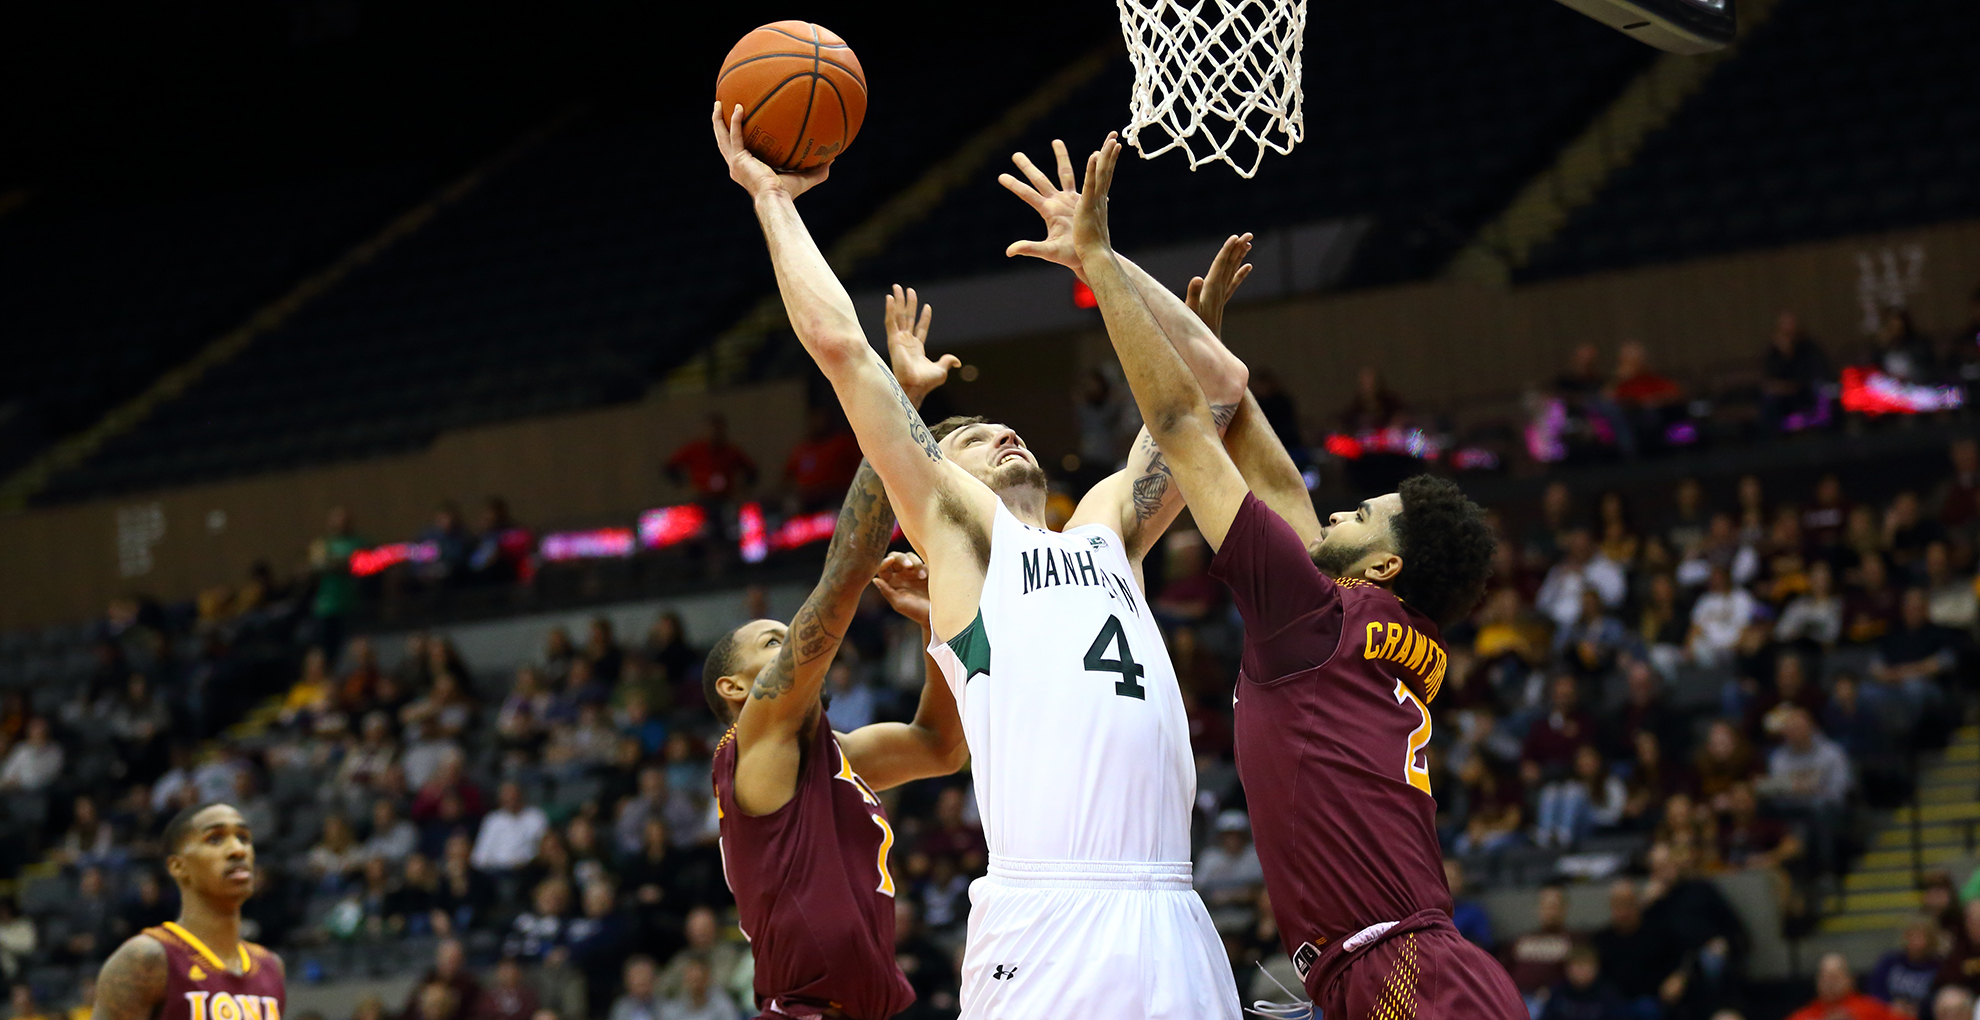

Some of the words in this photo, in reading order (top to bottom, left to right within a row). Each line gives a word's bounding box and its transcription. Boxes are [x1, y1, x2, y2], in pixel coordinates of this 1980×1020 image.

[1021, 547, 1140, 619] MANHN
[1083, 613, 1146, 701] 4
[1363, 621, 1448, 705] CRAWFORD
[1393, 677, 1433, 797] 2
